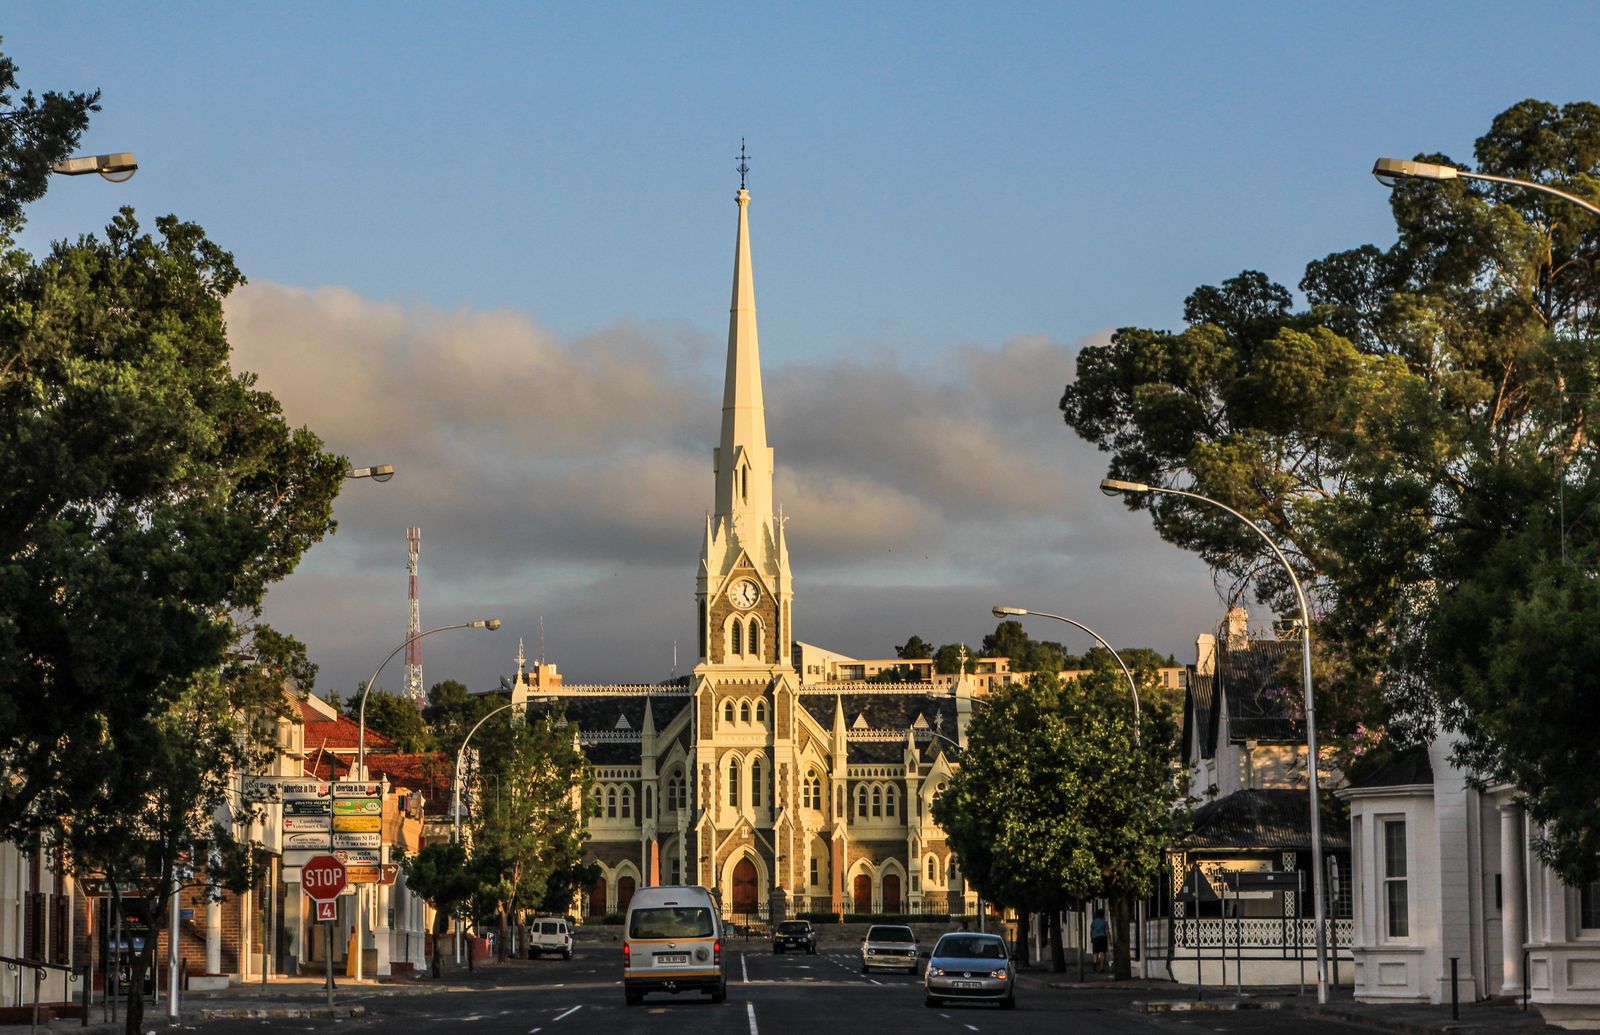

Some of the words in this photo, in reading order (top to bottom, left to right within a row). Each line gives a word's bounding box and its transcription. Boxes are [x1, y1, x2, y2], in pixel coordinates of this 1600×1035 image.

[284, 784, 302, 793] advertise
[303, 784, 308, 793] in
[308, 784, 317, 793] this
[305, 868, 342, 887] STOP
[322, 903, 332, 918] 4
